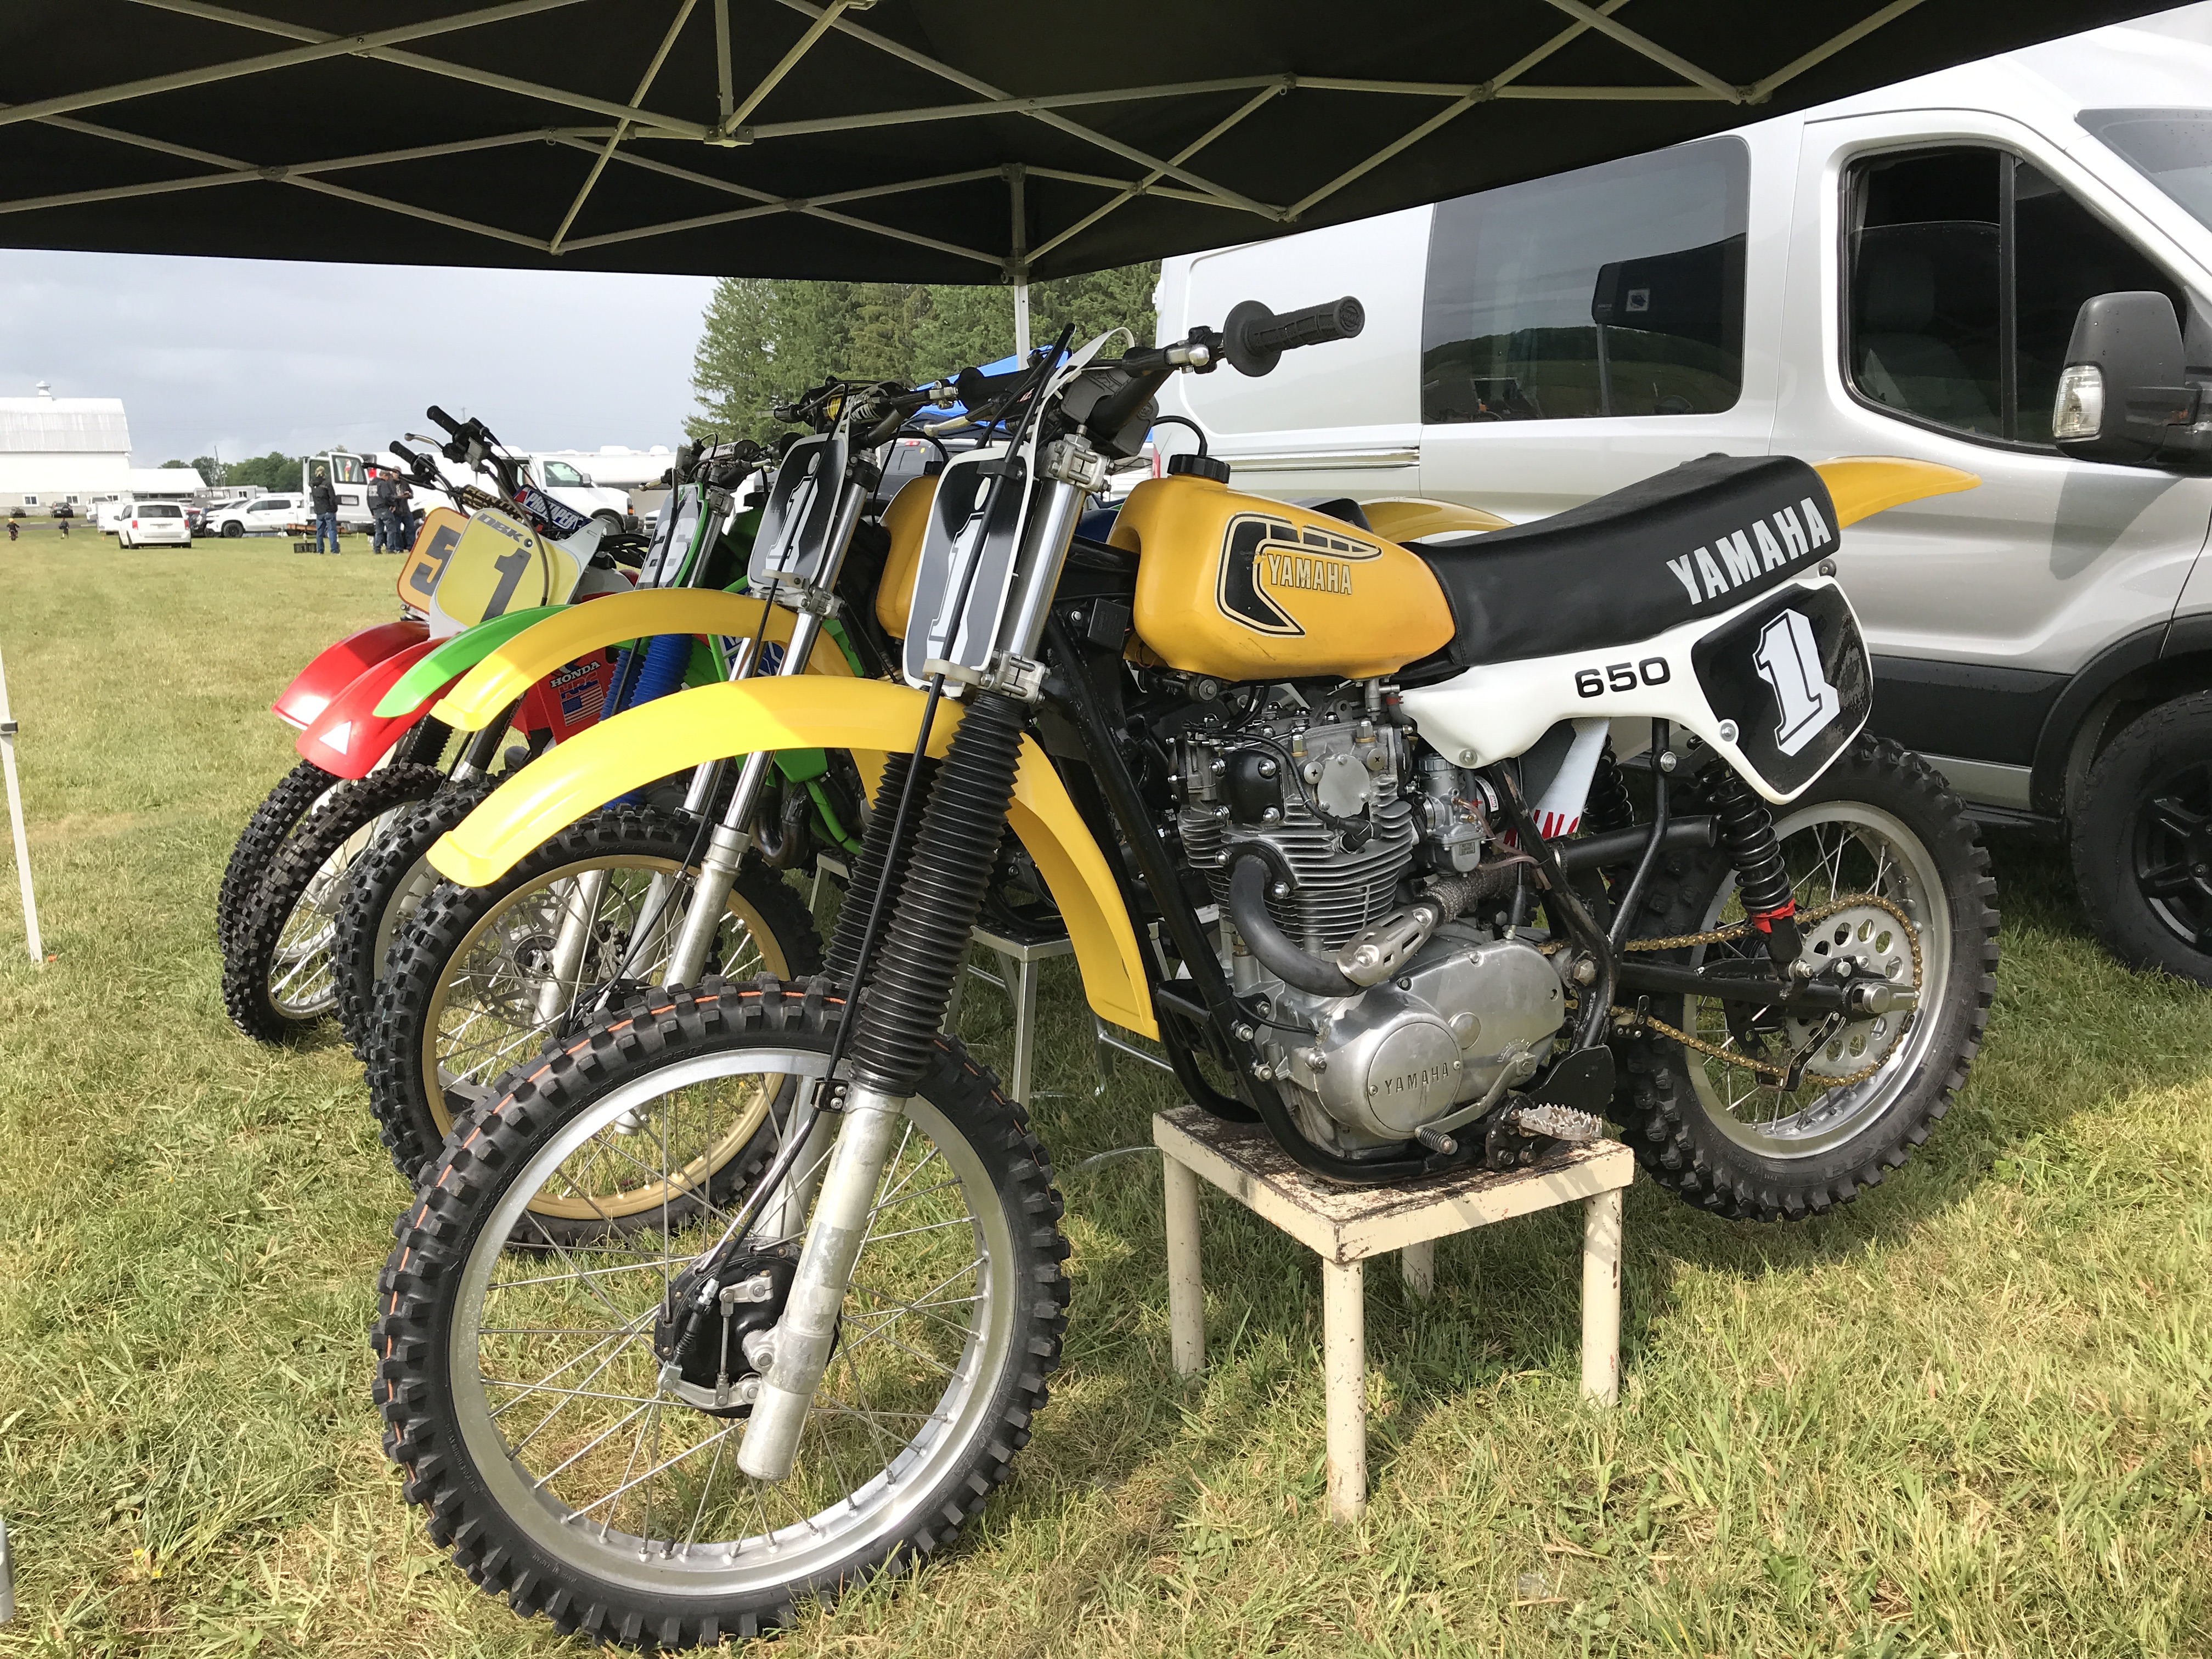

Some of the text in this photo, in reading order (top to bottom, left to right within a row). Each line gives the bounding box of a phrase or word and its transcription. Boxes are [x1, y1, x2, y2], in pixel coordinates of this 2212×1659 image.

[1666, 496, 1832, 605] YAMAHA
[480, 548, 532, 623] 1
[1267, 553, 1352, 595] YAMAHA
[550, 661, 601, 689] HONDA
[1574, 656, 1671, 698] 650
[1752, 608, 1841, 757] 1
[1384, 1062, 1449, 1096] YAMAHA
